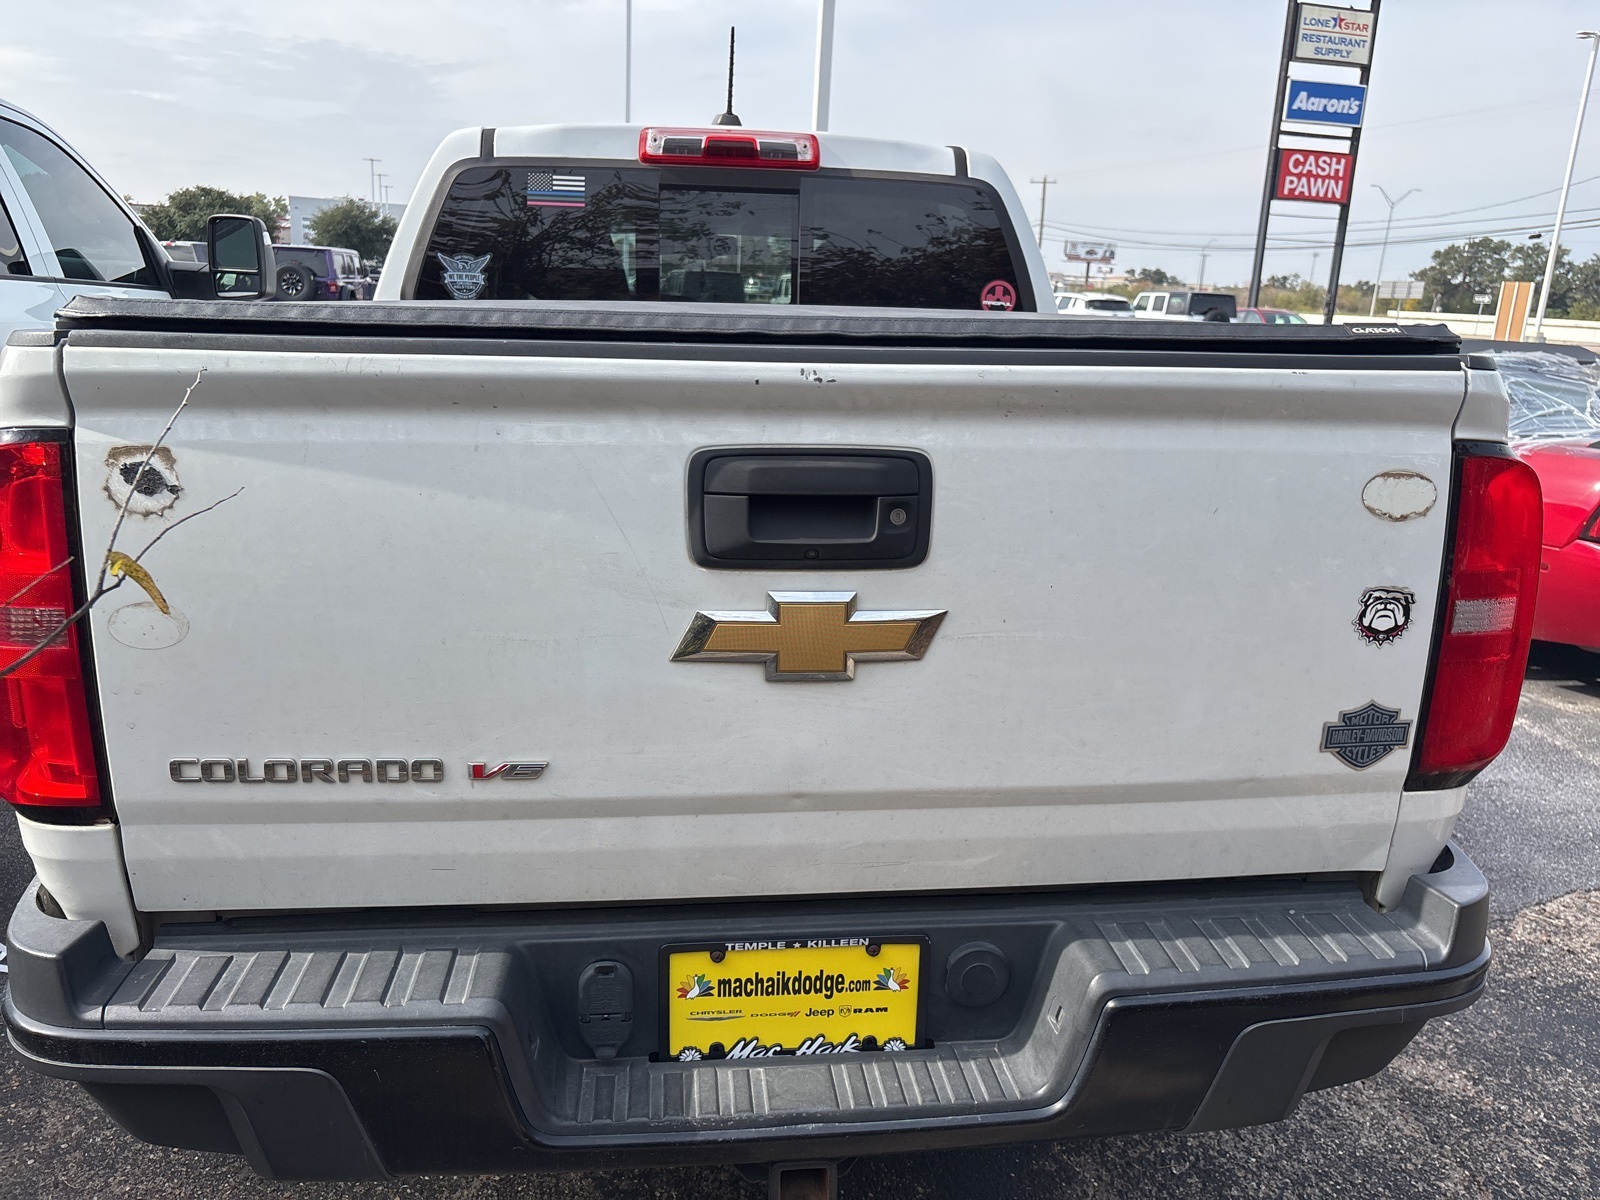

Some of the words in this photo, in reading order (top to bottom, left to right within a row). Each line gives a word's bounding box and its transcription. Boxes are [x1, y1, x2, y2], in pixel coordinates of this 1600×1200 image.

[1303, 16, 1331, 28] LONE
[1343, 20, 1369, 33] STAR
[1301, 33, 1368, 48] RESTAURANT
[1314, 46, 1352, 58] SUPPLY
[1291, 91, 1361, 114] Aaron's
[1288, 153, 1345, 177] CASH
[1283, 176, 1343, 198] PAWN
[448, 273, 456, 281] WE
[1351, 710, 1390, 725] MOTOR
[1331, 727, 1405, 744] HARLEY-DAVIDSON
[1345, 746, 1384, 762] CYCLES
[168, 757, 444, 784] COLORADO
[467, 761, 550, 781] V6
[725, 941, 786, 951] TEMPLE
[807, 938, 870, 949] KILLEEN
[717, 969, 871, 999] machaikdodge.com
[805, 1007, 835, 1018] Jeep
[853, 1006, 889, 1014] RAM
[725, 1037, 784, 1060] Mac
[795, 1033, 861, 1056] Haik
